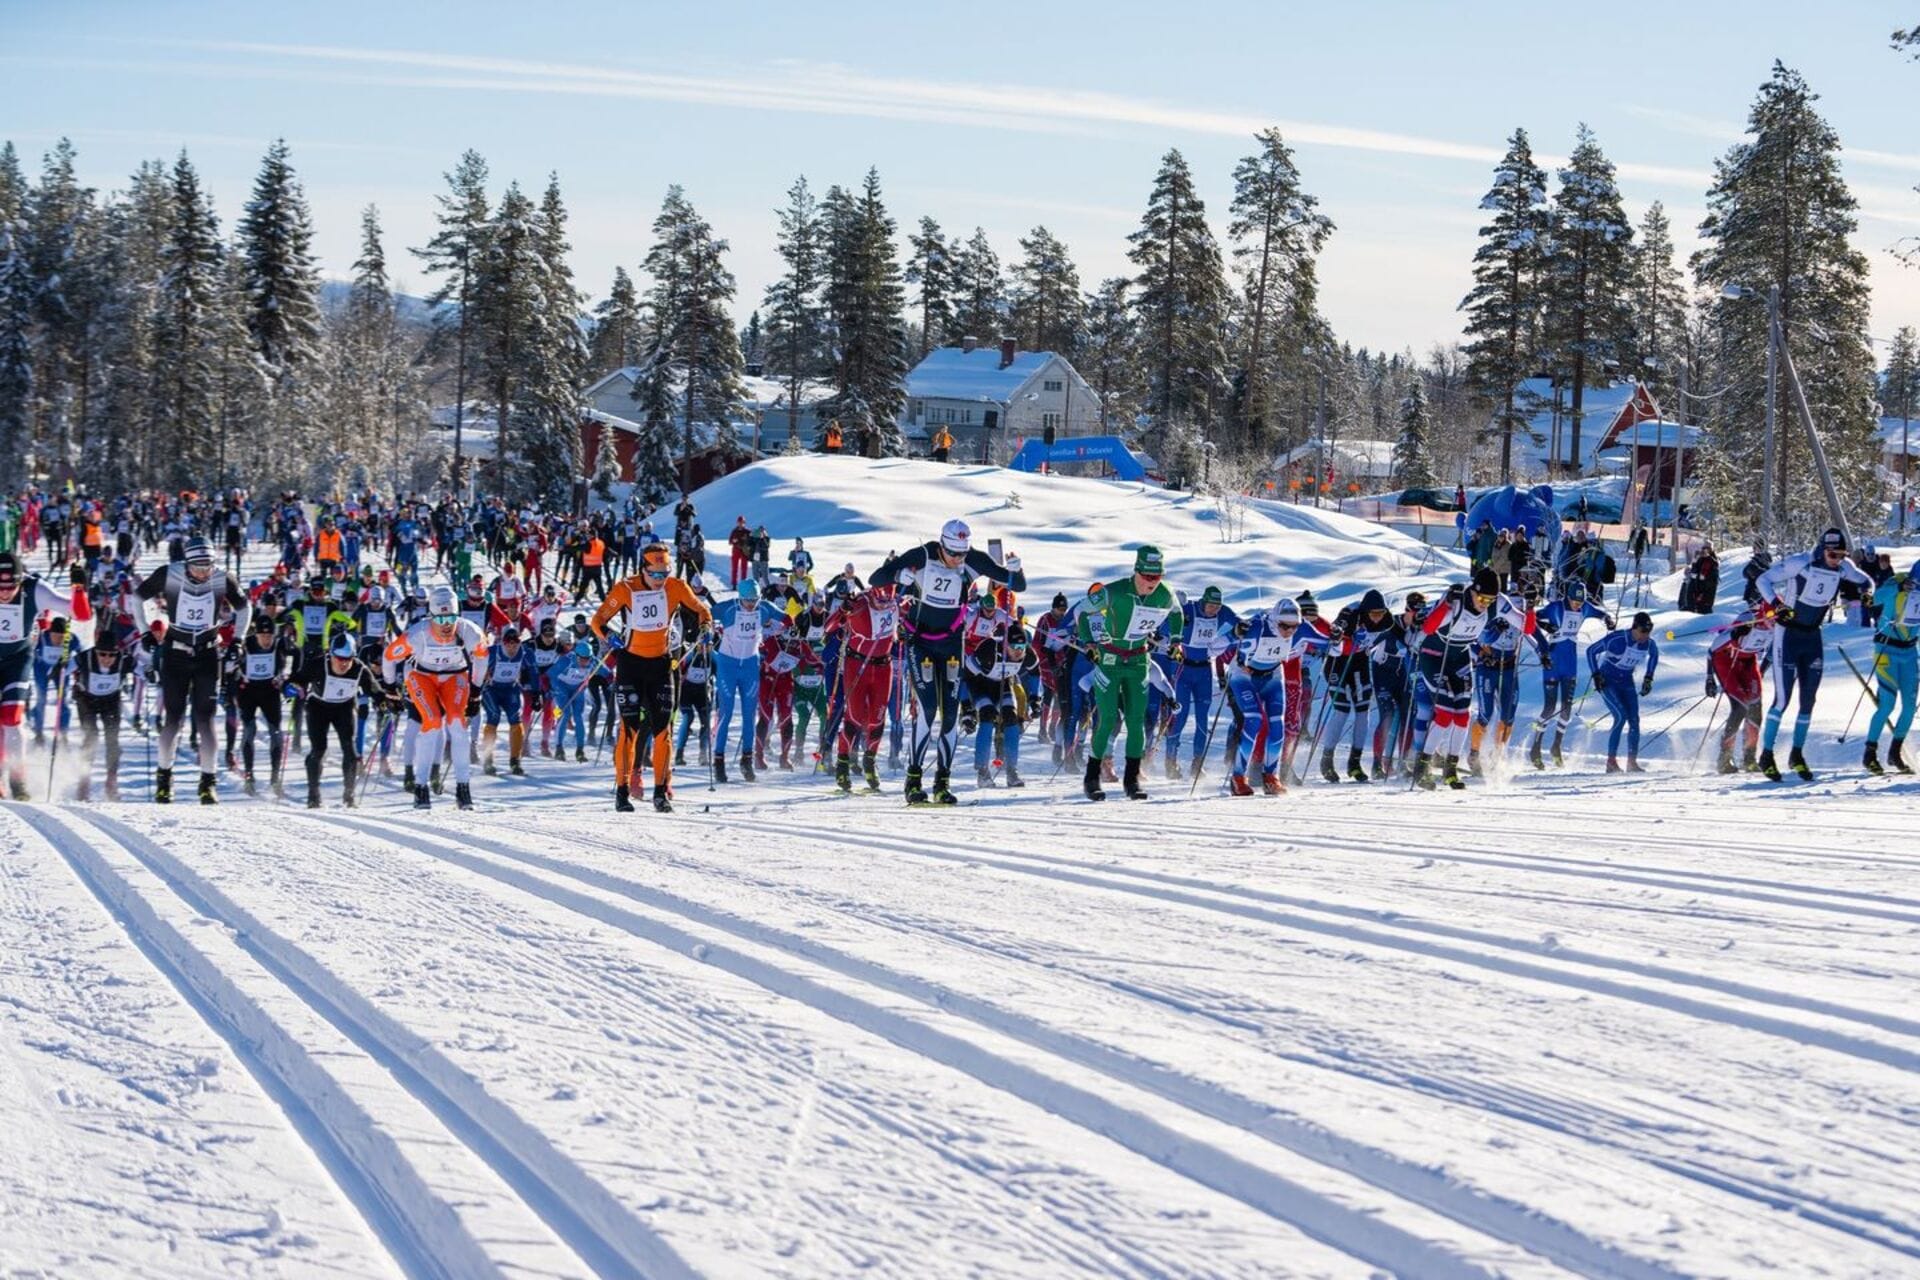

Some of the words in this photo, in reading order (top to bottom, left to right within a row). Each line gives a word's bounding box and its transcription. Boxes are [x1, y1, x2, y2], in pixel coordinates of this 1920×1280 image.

[933, 577, 952, 593] 27
[1815, 583, 1825, 595] 3
[642, 604, 658, 619] 30
[1914, 603, 1920, 613] 1
[186, 608, 205, 621] 32
[740, 622, 757, 632] 104
[1139, 619, 1156, 631] 22
[1567, 620, 1578, 629] 31
[1197, 629, 1213, 639] 146
[1267, 646, 1281, 656] 14
[336, 687, 345, 697] 4
